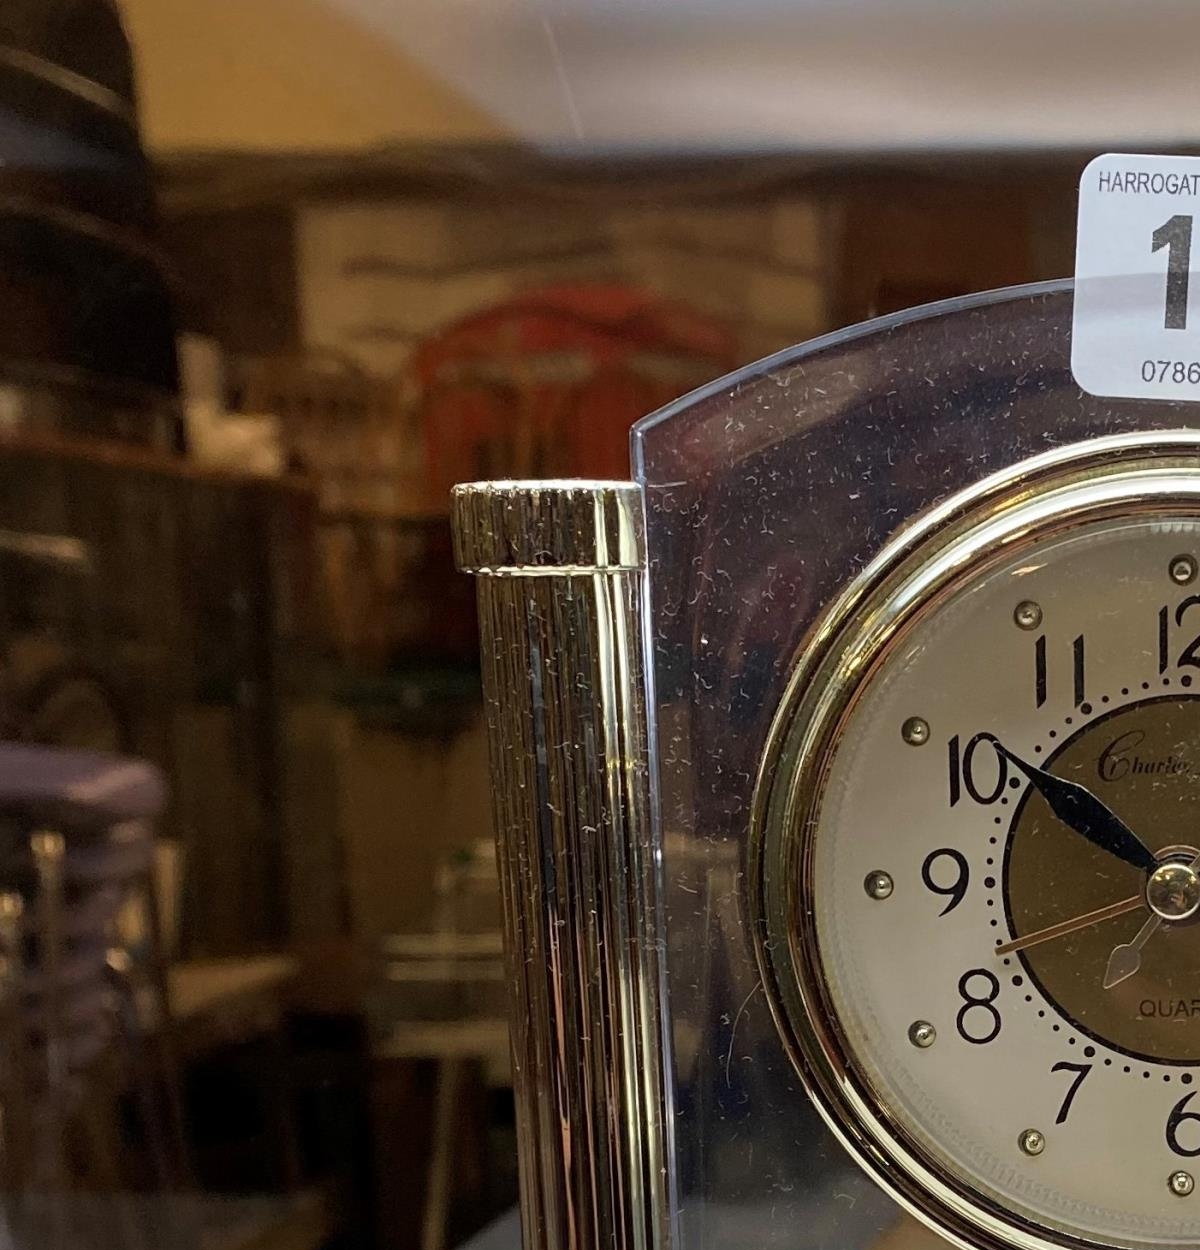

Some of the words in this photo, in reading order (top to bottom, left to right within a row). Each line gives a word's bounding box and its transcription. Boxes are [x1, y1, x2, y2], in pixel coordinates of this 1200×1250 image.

[1035, 634, 1085, 709] 11
[947, 731, 1009, 808] 10
[920, 848, 971, 918] 9
[955, 967, 1003, 1045] 8
[1050, 1061, 1093, 1126] 7
